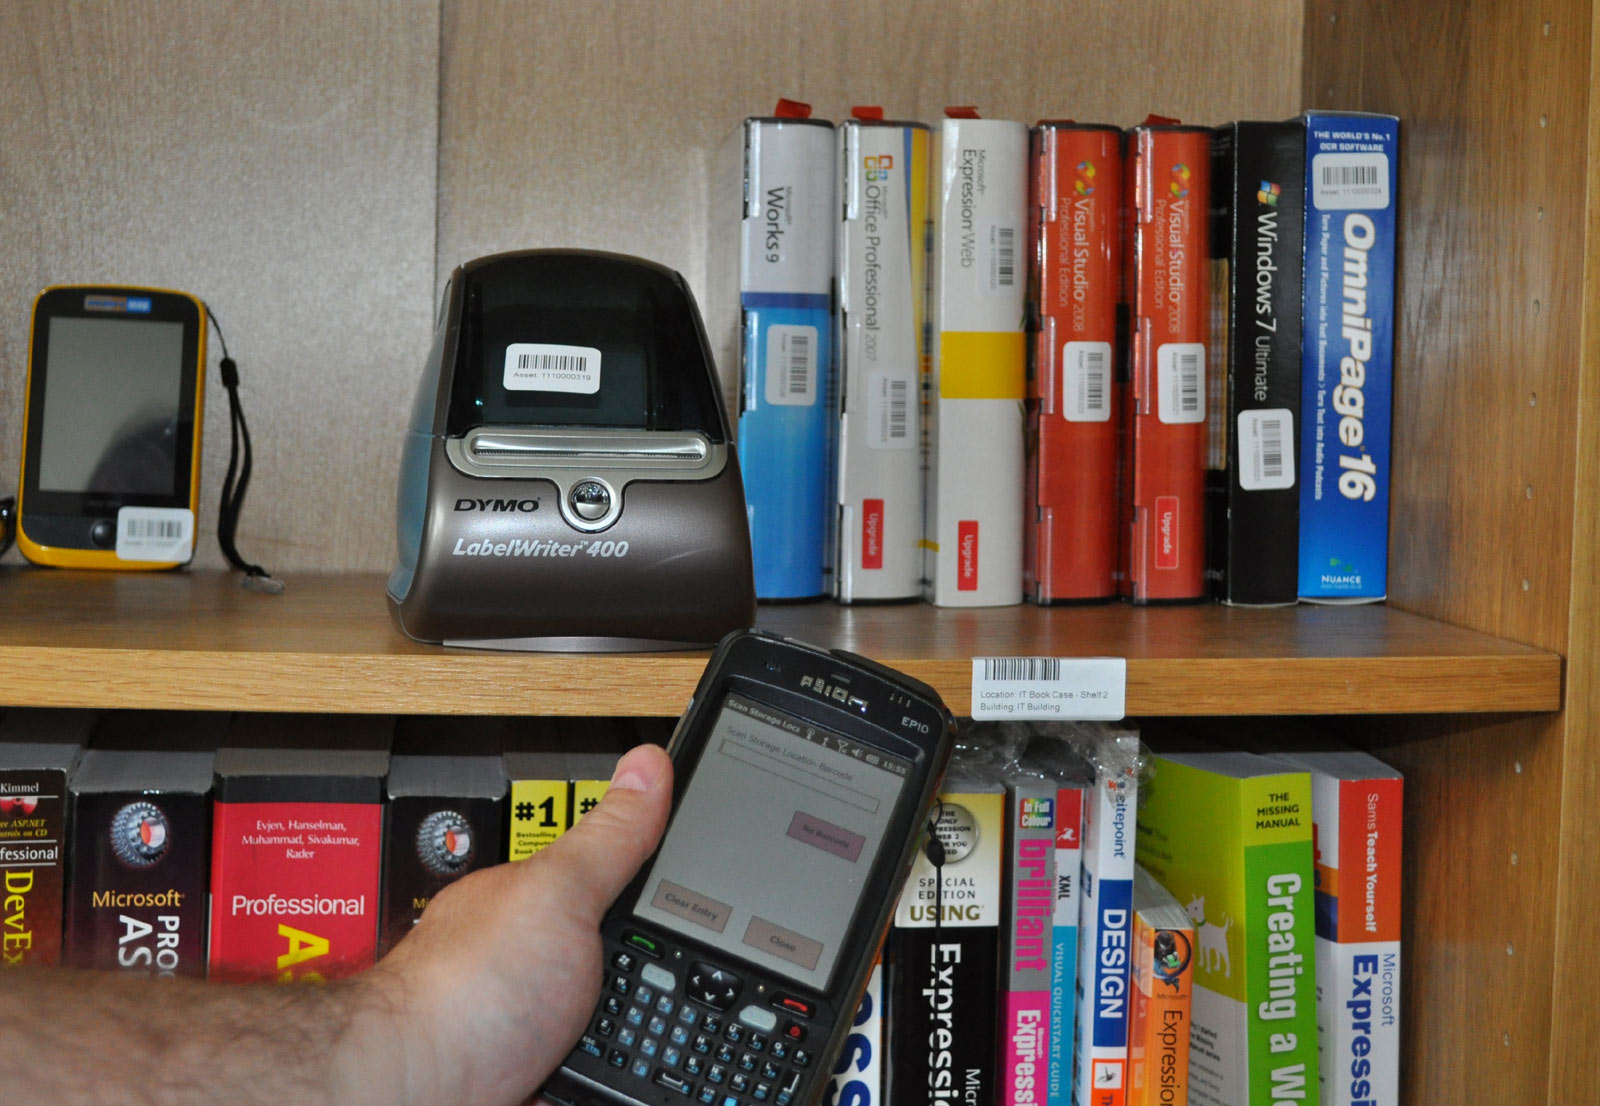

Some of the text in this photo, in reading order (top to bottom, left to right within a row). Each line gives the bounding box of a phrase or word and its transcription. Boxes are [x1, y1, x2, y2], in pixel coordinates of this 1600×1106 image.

[1314, 131, 1330, 139] THE
[1332, 131, 1369, 140] WORLD'S
[1320, 142, 1384, 152] OCR SOFTWARE
[960, 148, 976, 268] Expression Web
[766, 187, 785, 263] Works 9
[1059, 198, 1071, 307] Professional Edition
[1073, 199, 1089, 332] Visual Studio 2008
[1155, 200, 1166, 309] Professional Edition
[864, 184, 880, 362] Office Professional 2007
[1168, 200, 1184, 334] Visual Studio 2008
[1255, 212, 1278, 401] Windows 7 Ultimate
[1333, 213, 1377, 502] OmniPage 16
[513, 371, 591, 382] Asset: 1110000319
[454, 499, 539, 512] DYMO
[865, 513, 878, 556] Upgrade
[1161, 512, 1172, 554] Upgrade
[586, 541, 629, 557] 400
[962, 535, 974, 578] Upgrade
[1321, 574, 1361, 584] NUANCE
[980, 691, 1015, 699] Location:
[1029, 691, 1050, 699] Book
[1052, 691, 1074, 699] Case
[1080, 691, 1102, 699] Shelf
[980, 703, 1014, 713] Building:
[1027, 703, 1061, 712] Building
[728, 699, 748, 712] Scan
[750, 707, 782, 727] Storage
[727, 725, 853, 781] Scan Storage Location Barcode
[0, 782, 39, 793] Kimmel
[1268, 792, 1289, 802] THE
[515, 796, 558, 827] #1
[1024, 801, 1050, 812] In Full
[1257, 804, 1299, 816] MISSING
[35, 829, 48, 837] CD
[256, 820, 347, 832] Evjen, Hanselman,
[1022, 815, 1052, 826] Colour
[1113, 794, 1128, 857] sitepoint
[1256, 818, 1300, 829] MANUAL
[242, 835, 360, 847] Muhammad, Sivakumar,
[286, 849, 315, 859] Rader
[1365, 793, 1378, 933] Sams Teach Yourself
[92, 889, 181, 908] Microsoft
[1058, 875, 1071, 900] XML
[232, 894, 365, 916] Professional
[664, 892, 719, 920] Clear Entry
[910, 905, 980, 921] USING
[1015, 839, 1053, 971] brilliant
[769, 936, 796, 952] Close
[1259, 873, 1303, 1020] Creating
[1100, 909, 1126, 1019] DESIGN
[1382, 953, 1396, 1026] Microsoft
[1050, 942, 1064, 1097] VISUAL QUICKSTART GUIDE
[1270, 1033, 1297, 1053] a
[1157, 1010, 1182, 1106] Expressio
